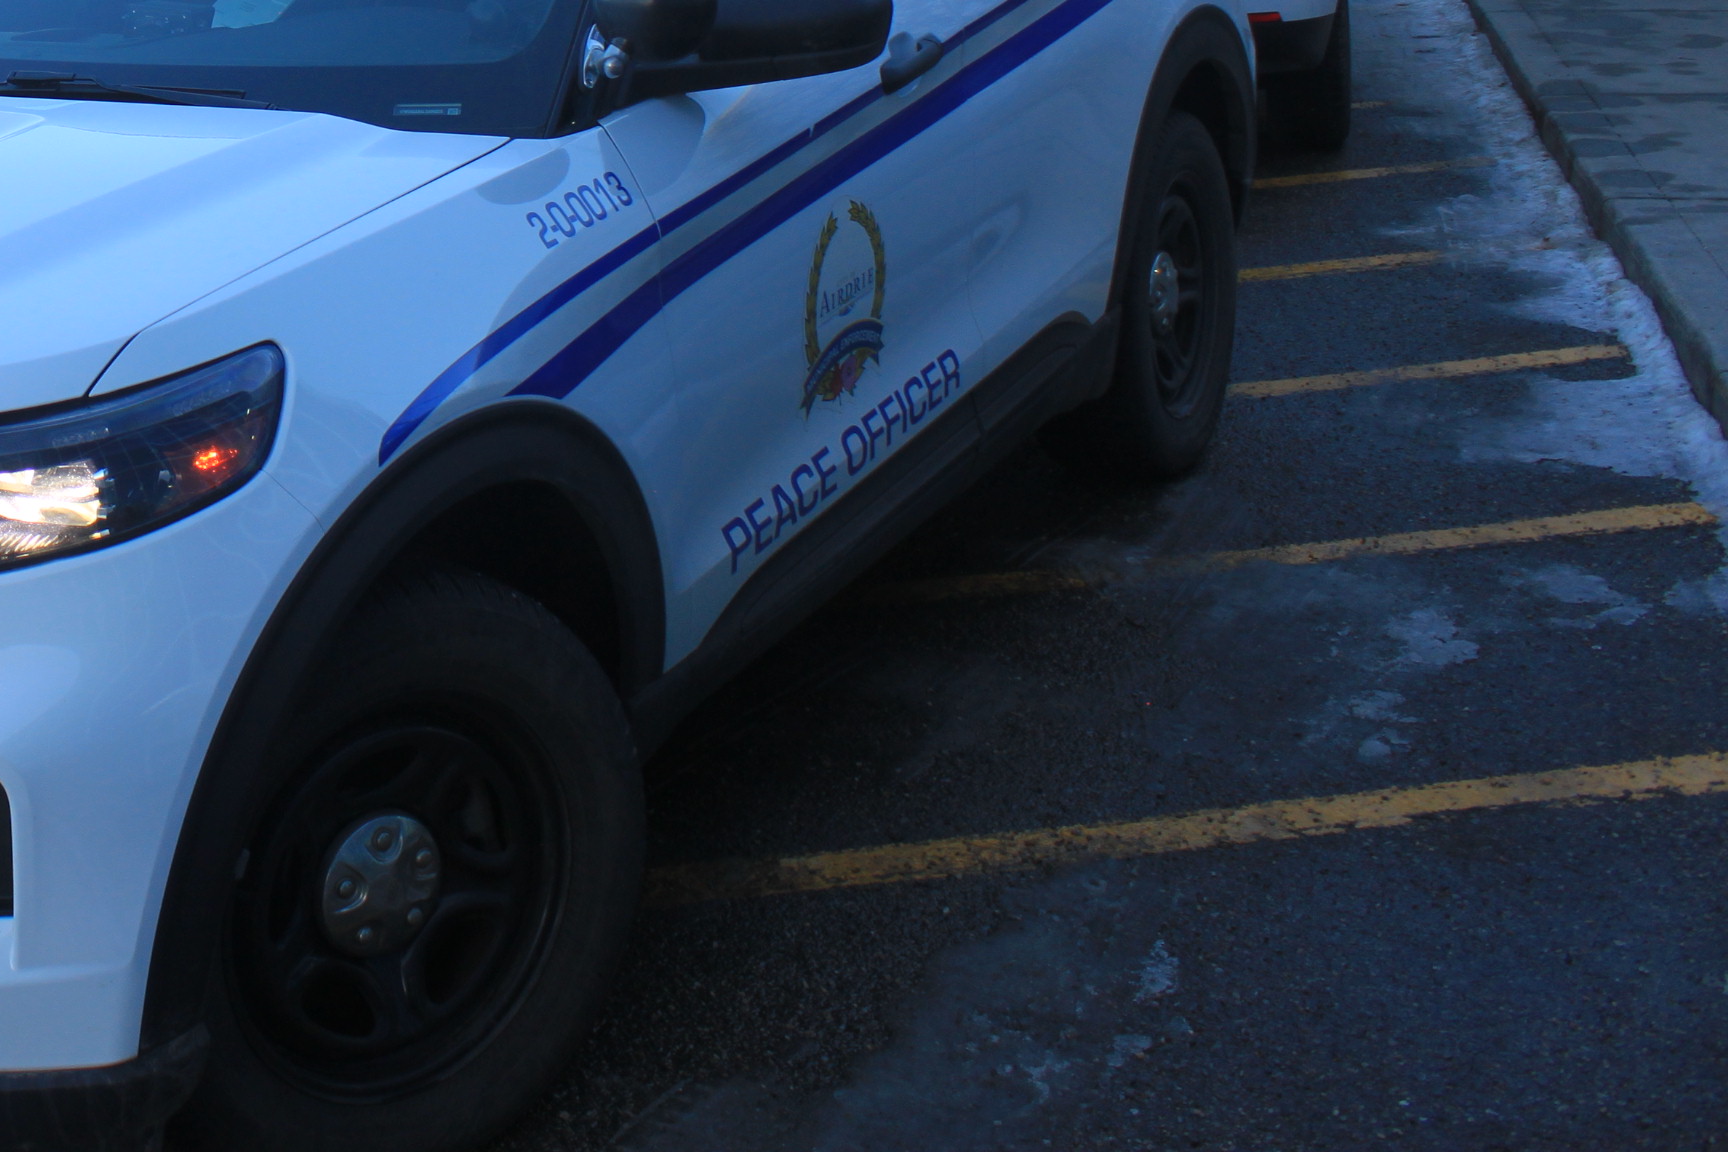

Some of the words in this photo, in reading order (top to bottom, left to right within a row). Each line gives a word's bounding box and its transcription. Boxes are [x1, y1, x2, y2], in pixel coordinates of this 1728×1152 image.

[526, 171, 633, 249] 2-0-0013
[820, 267, 874, 318] AIRDRIE
[721, 446, 837, 575] PEACE
[841, 349, 960, 476] OFFICER
